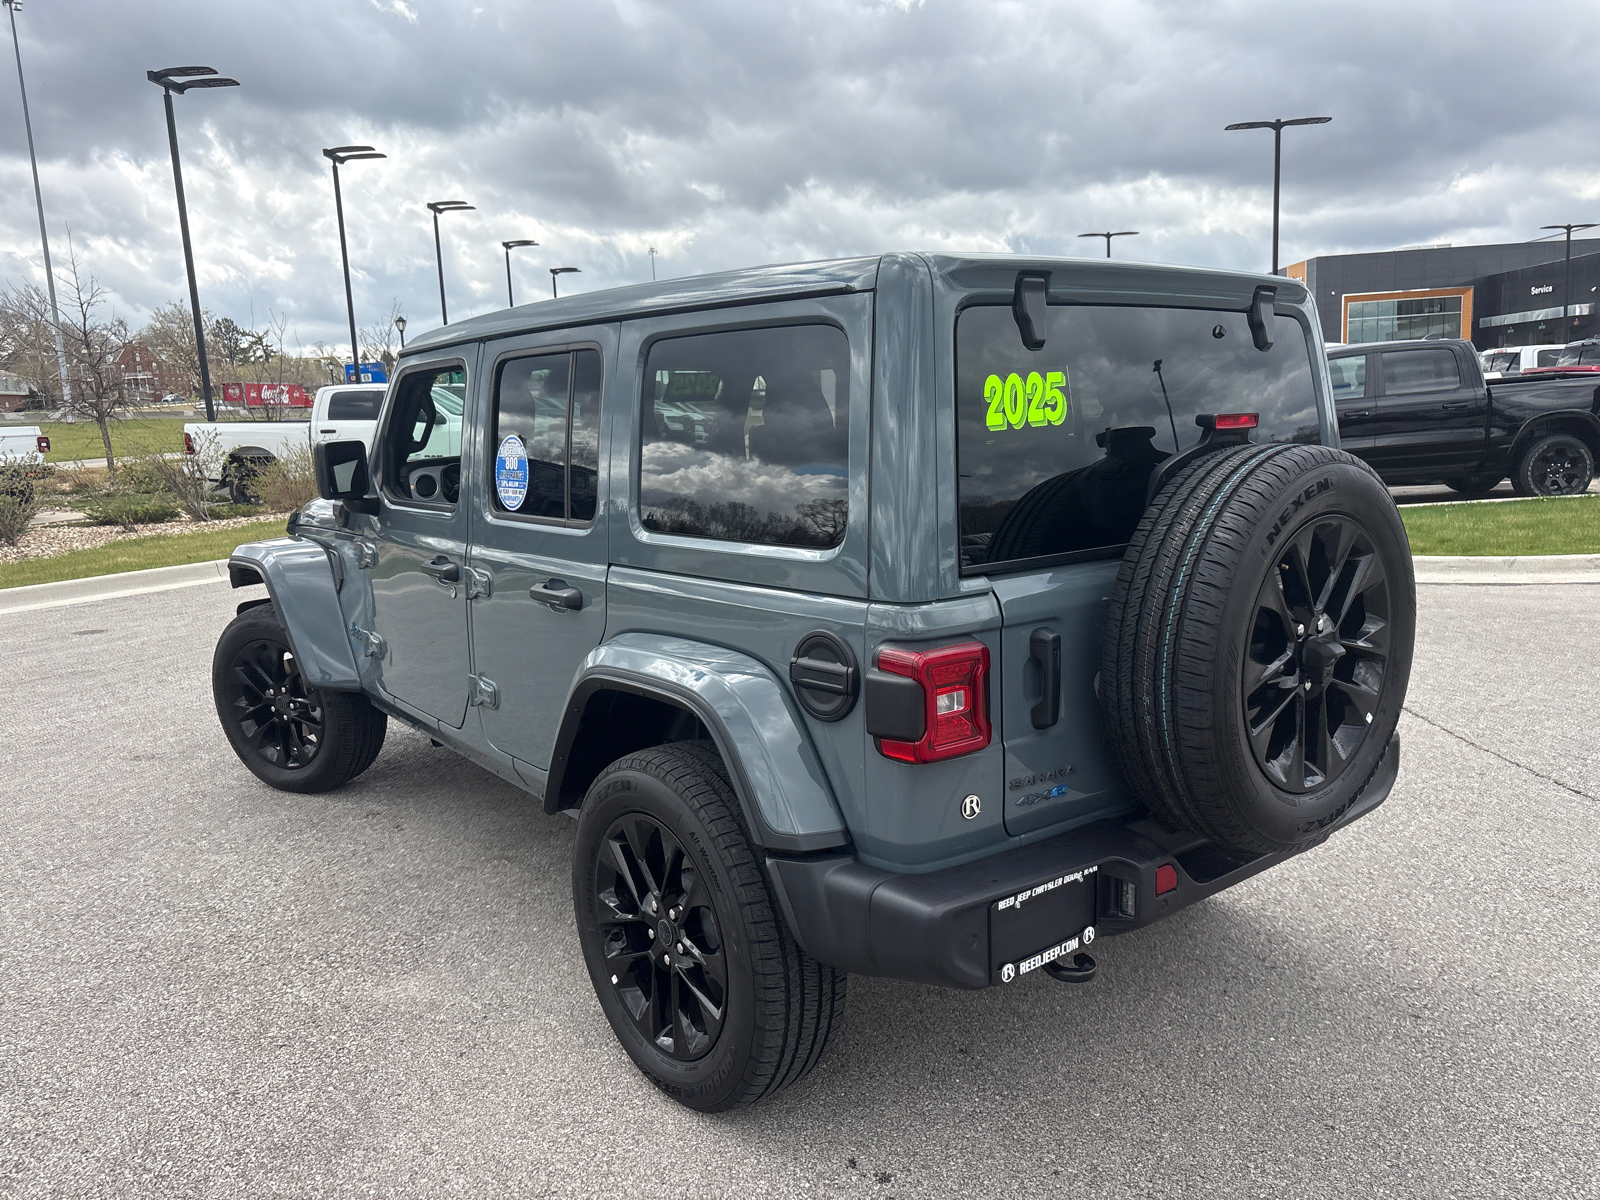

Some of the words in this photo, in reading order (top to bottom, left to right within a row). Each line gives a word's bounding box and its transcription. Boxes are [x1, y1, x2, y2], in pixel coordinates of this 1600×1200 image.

[1530, 285, 1553, 296] Service
[984, 371, 1068, 431] 2025
[505, 456, 518, 470] 800
[1266, 477, 1331, 547] NEXEN
[1009, 765, 1076, 791] SAHARA
[688, 831, 723, 894] All-Weather
[998, 896, 1015, 911] REED
[1015, 890, 1031, 905] JEEP
[1032, 877, 1062, 897] CHRYSLER
[1084, 865, 1098, 876] RAM
[1019, 936, 1079, 975] REEDJEEP.COM
